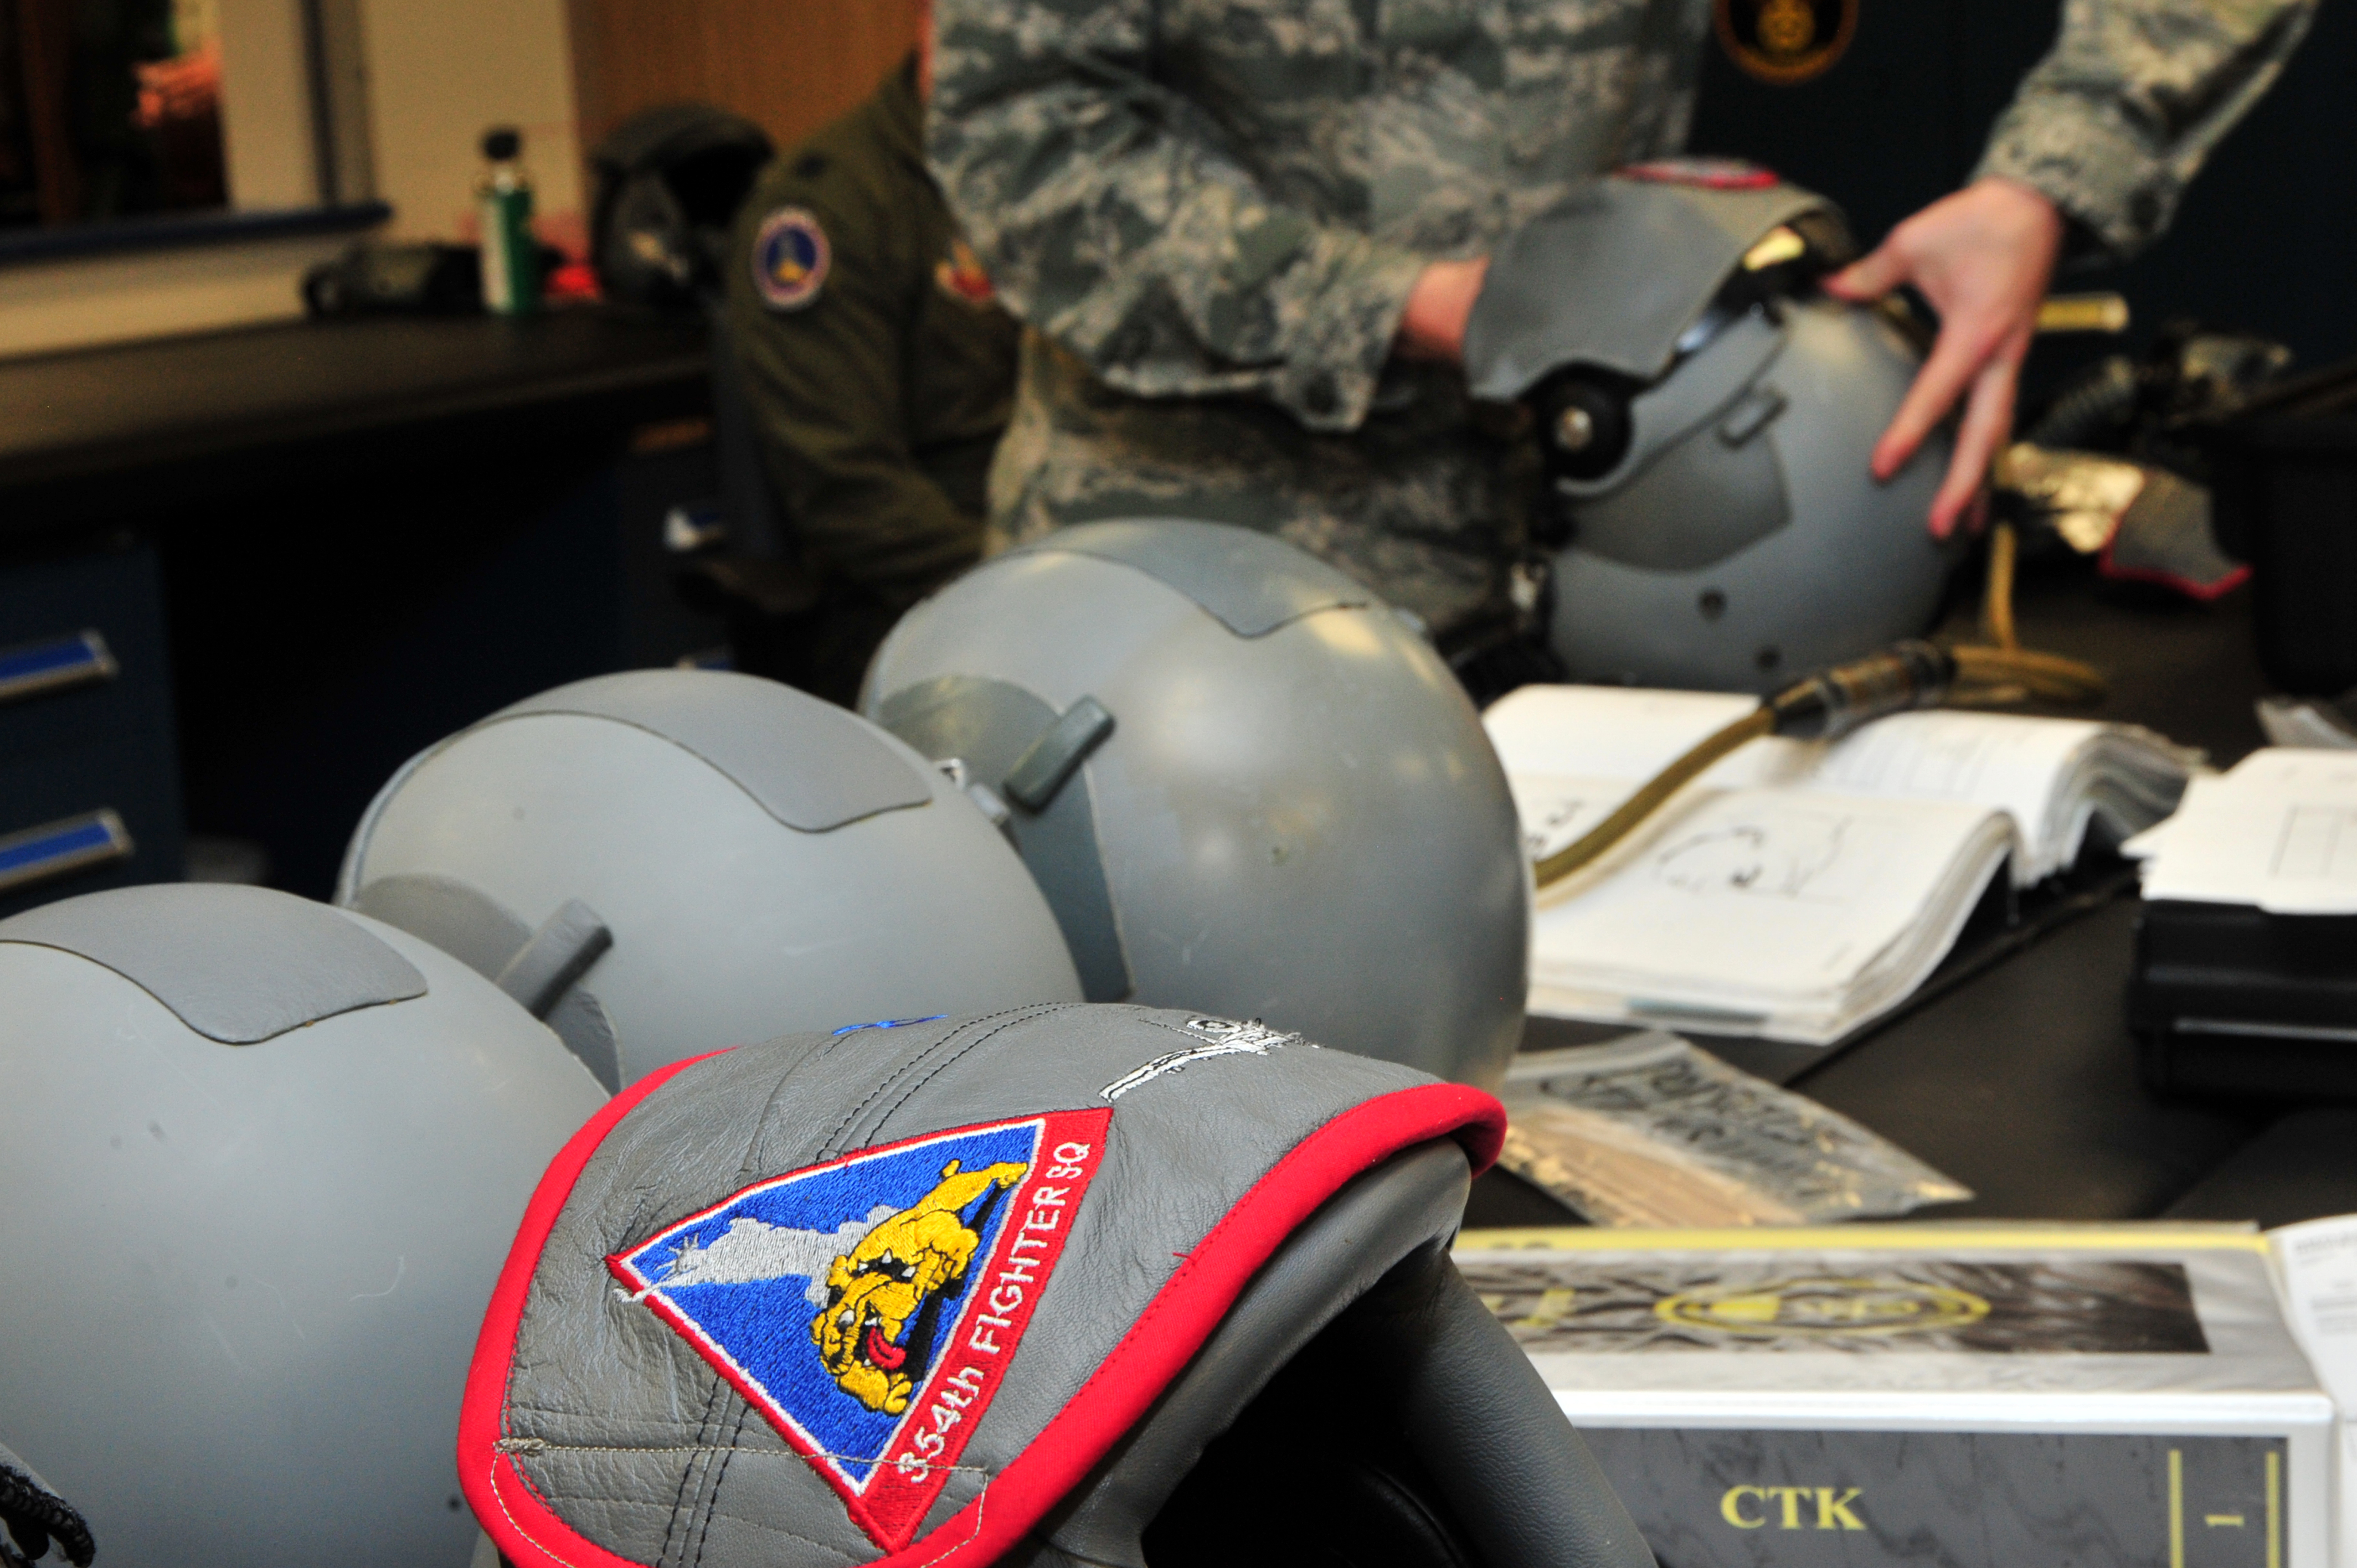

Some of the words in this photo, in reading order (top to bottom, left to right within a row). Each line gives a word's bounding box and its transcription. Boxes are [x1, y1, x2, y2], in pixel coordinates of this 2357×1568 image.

[897, 1366, 985, 1483] 354th
[967, 1186, 1071, 1355] FIGHTER
[1045, 1142, 1091, 1179] SQ
[1720, 1484, 1867, 1530] CTK
